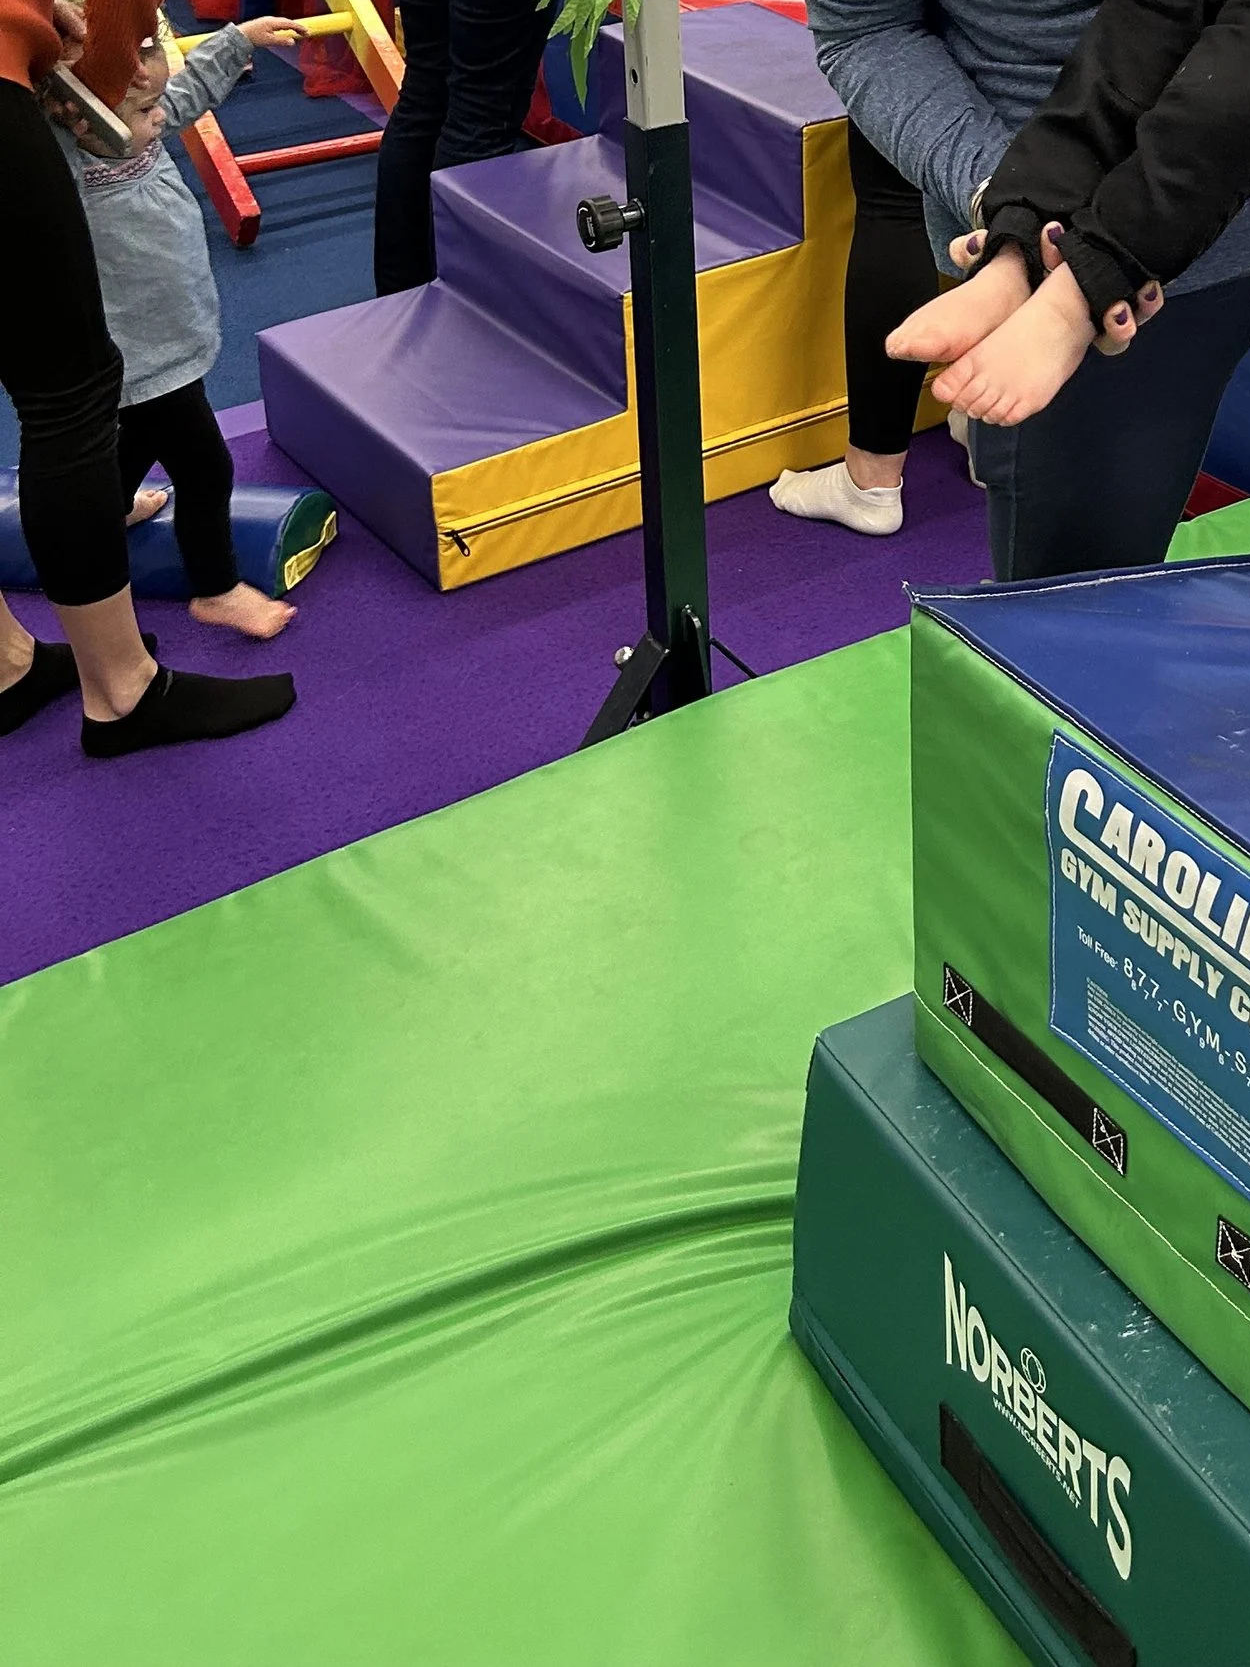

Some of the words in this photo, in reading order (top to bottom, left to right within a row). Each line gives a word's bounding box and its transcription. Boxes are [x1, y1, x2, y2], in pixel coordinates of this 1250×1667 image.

[1060, 847, 1118, 917] GYM
[1122, 898, 1225, 999] SUPPLY
[1076, 925, 1093, 949] Toll
[1094, 941, 1119, 971] Free:
[943, 1250, 1133, 1581] NORBERTS
